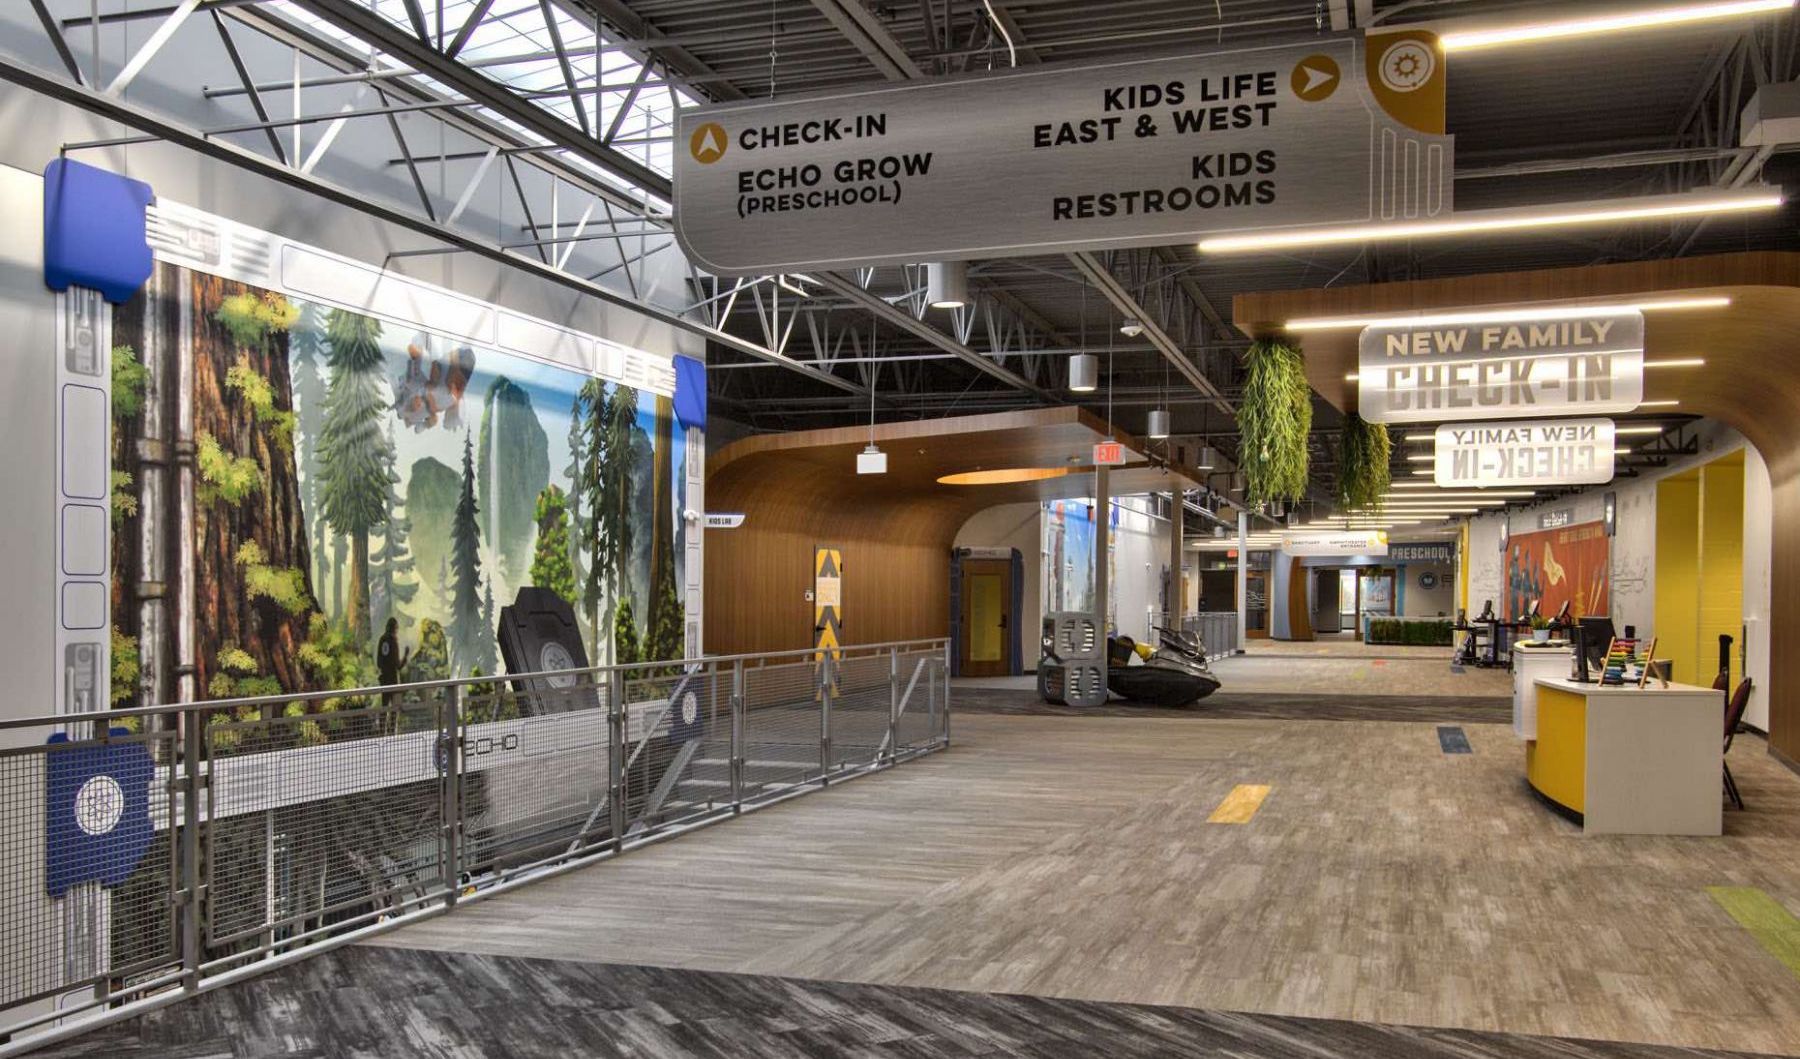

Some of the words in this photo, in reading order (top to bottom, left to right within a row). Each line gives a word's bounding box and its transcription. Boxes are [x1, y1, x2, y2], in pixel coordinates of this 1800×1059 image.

[1104, 81, 1185, 112] KIDS
[1200, 71, 1277, 102] LIFE
[739, 113, 886, 150] CHECK-IN
[1034, 117, 1121, 148] EAST
[1134, 114, 1158, 138] &
[1172, 102, 1277, 134] WEST
[738, 164, 821, 193] ECHO
[834, 152, 932, 183] GROW
[1192, 150, 1276, 180] KIDS
[737, 180, 901, 219] (PRESCHOOL)
[1053, 180, 1276, 221] RESTROOMS
[1386, 328, 1468, 357] NEW
[1482, 319, 1615, 350] FAMILY
[1386, 355, 1612, 410] CHECK-IN
[1391, 546, 1449, 560] PRESCHOOL
